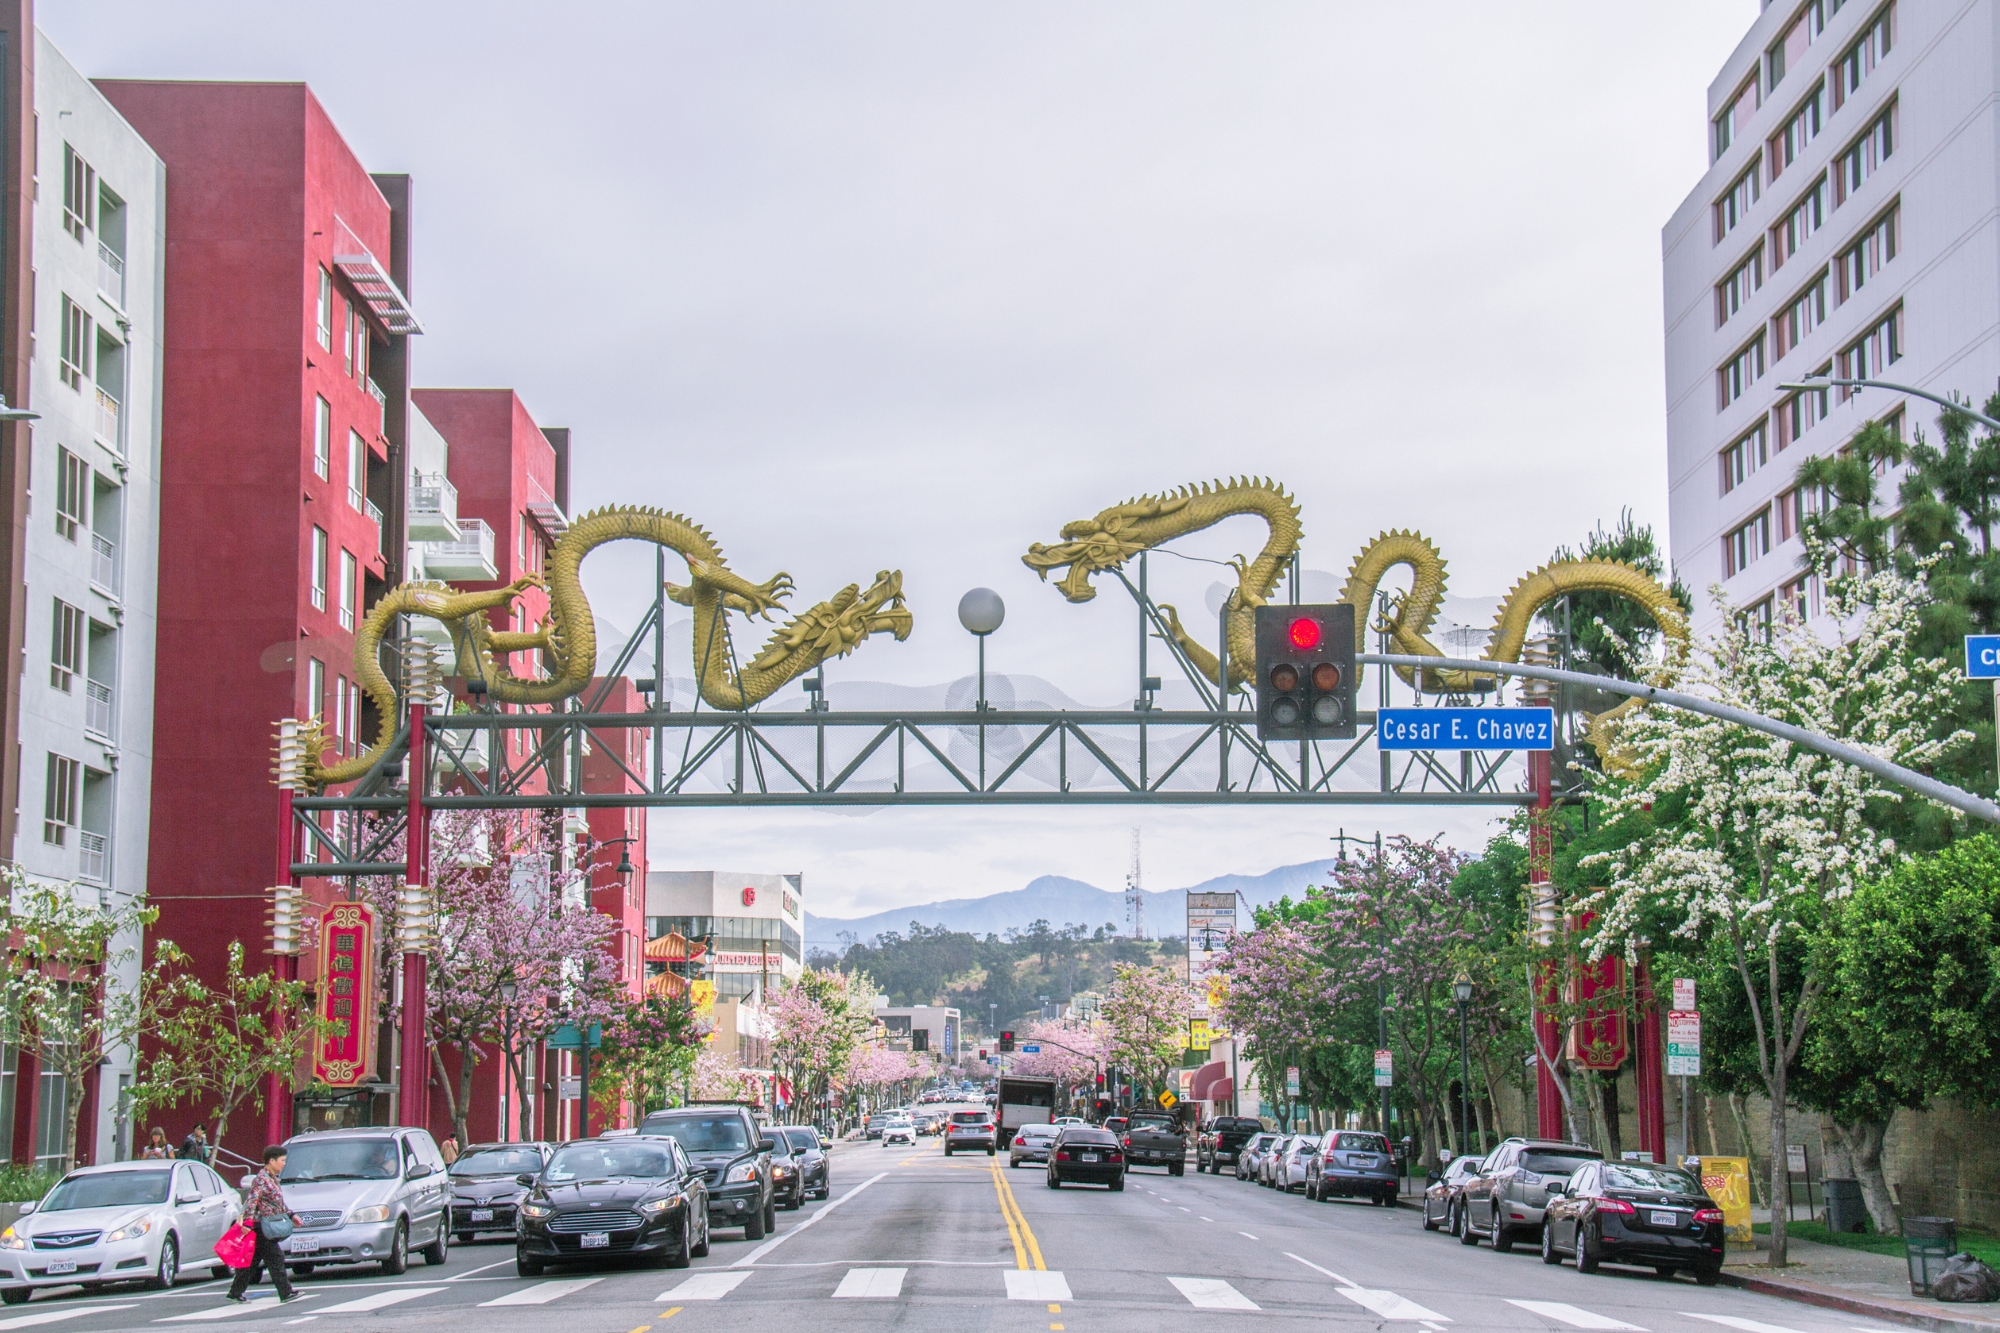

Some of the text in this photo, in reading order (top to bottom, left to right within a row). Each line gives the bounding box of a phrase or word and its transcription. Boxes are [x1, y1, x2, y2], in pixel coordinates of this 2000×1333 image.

[1383, 718, 1547, 740] Cesar E. Chavez
[1669, 1017, 1678, 1027] NO
[1670, 1043, 1677, 1052] 2
